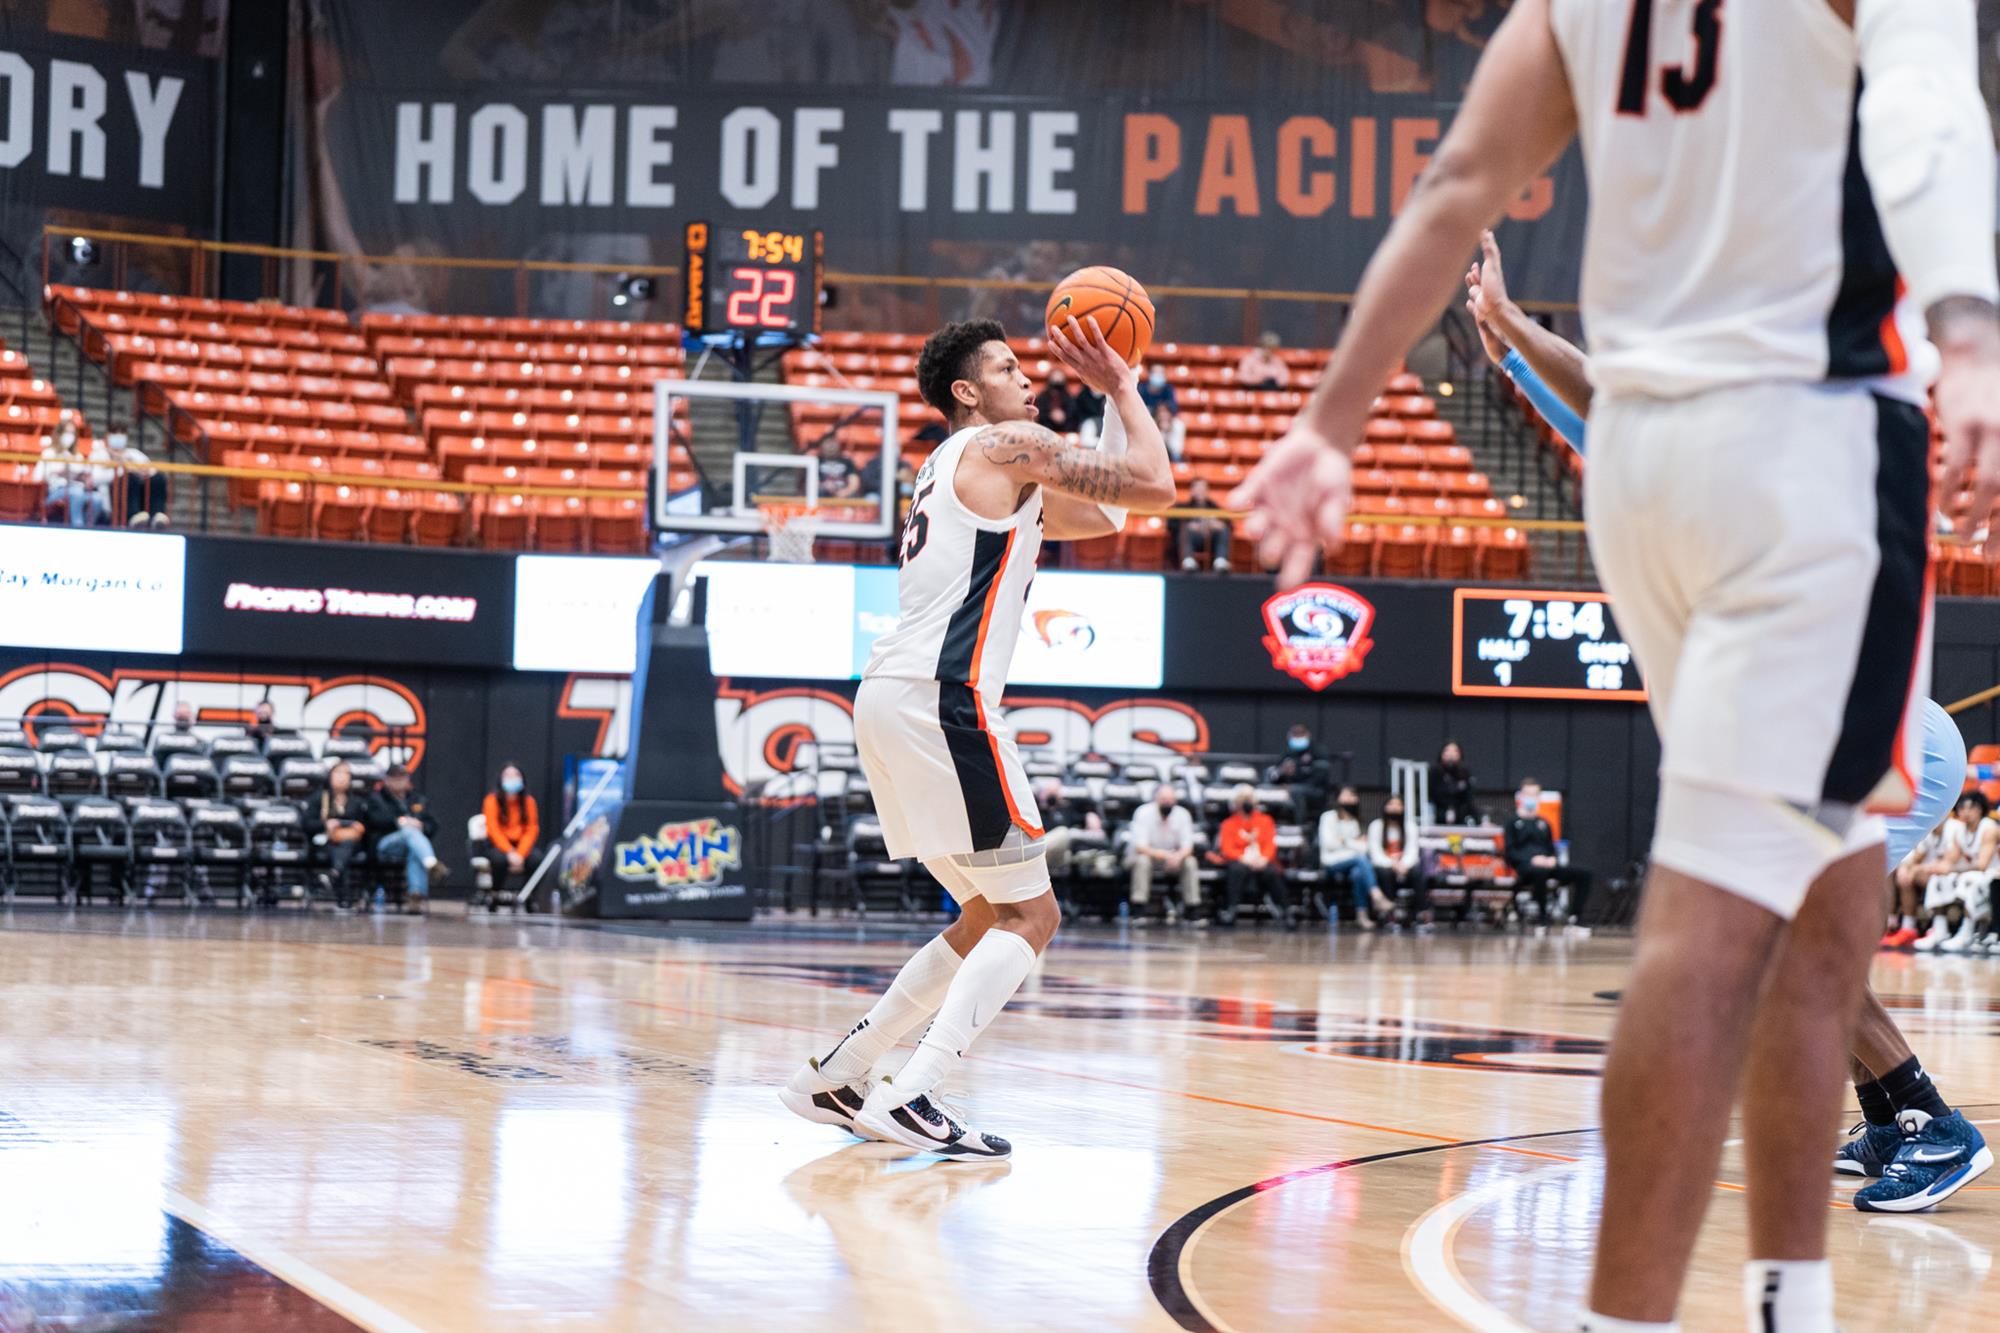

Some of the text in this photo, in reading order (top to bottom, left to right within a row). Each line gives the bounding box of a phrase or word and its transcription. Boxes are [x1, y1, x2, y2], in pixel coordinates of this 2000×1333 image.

[394, 102, 1555, 221] HOME OF THE PACIF
[742, 230, 803, 264] 7:54
[727, 267, 796, 327] 22
[41, 572, 127, 592] Morgan
[1504, 599, 1605, 641] 7:54
[1478, 638, 1531, 661] HALF
[1494, 661, 1512, 686] 1
[624, 832, 729, 867] KWIN
